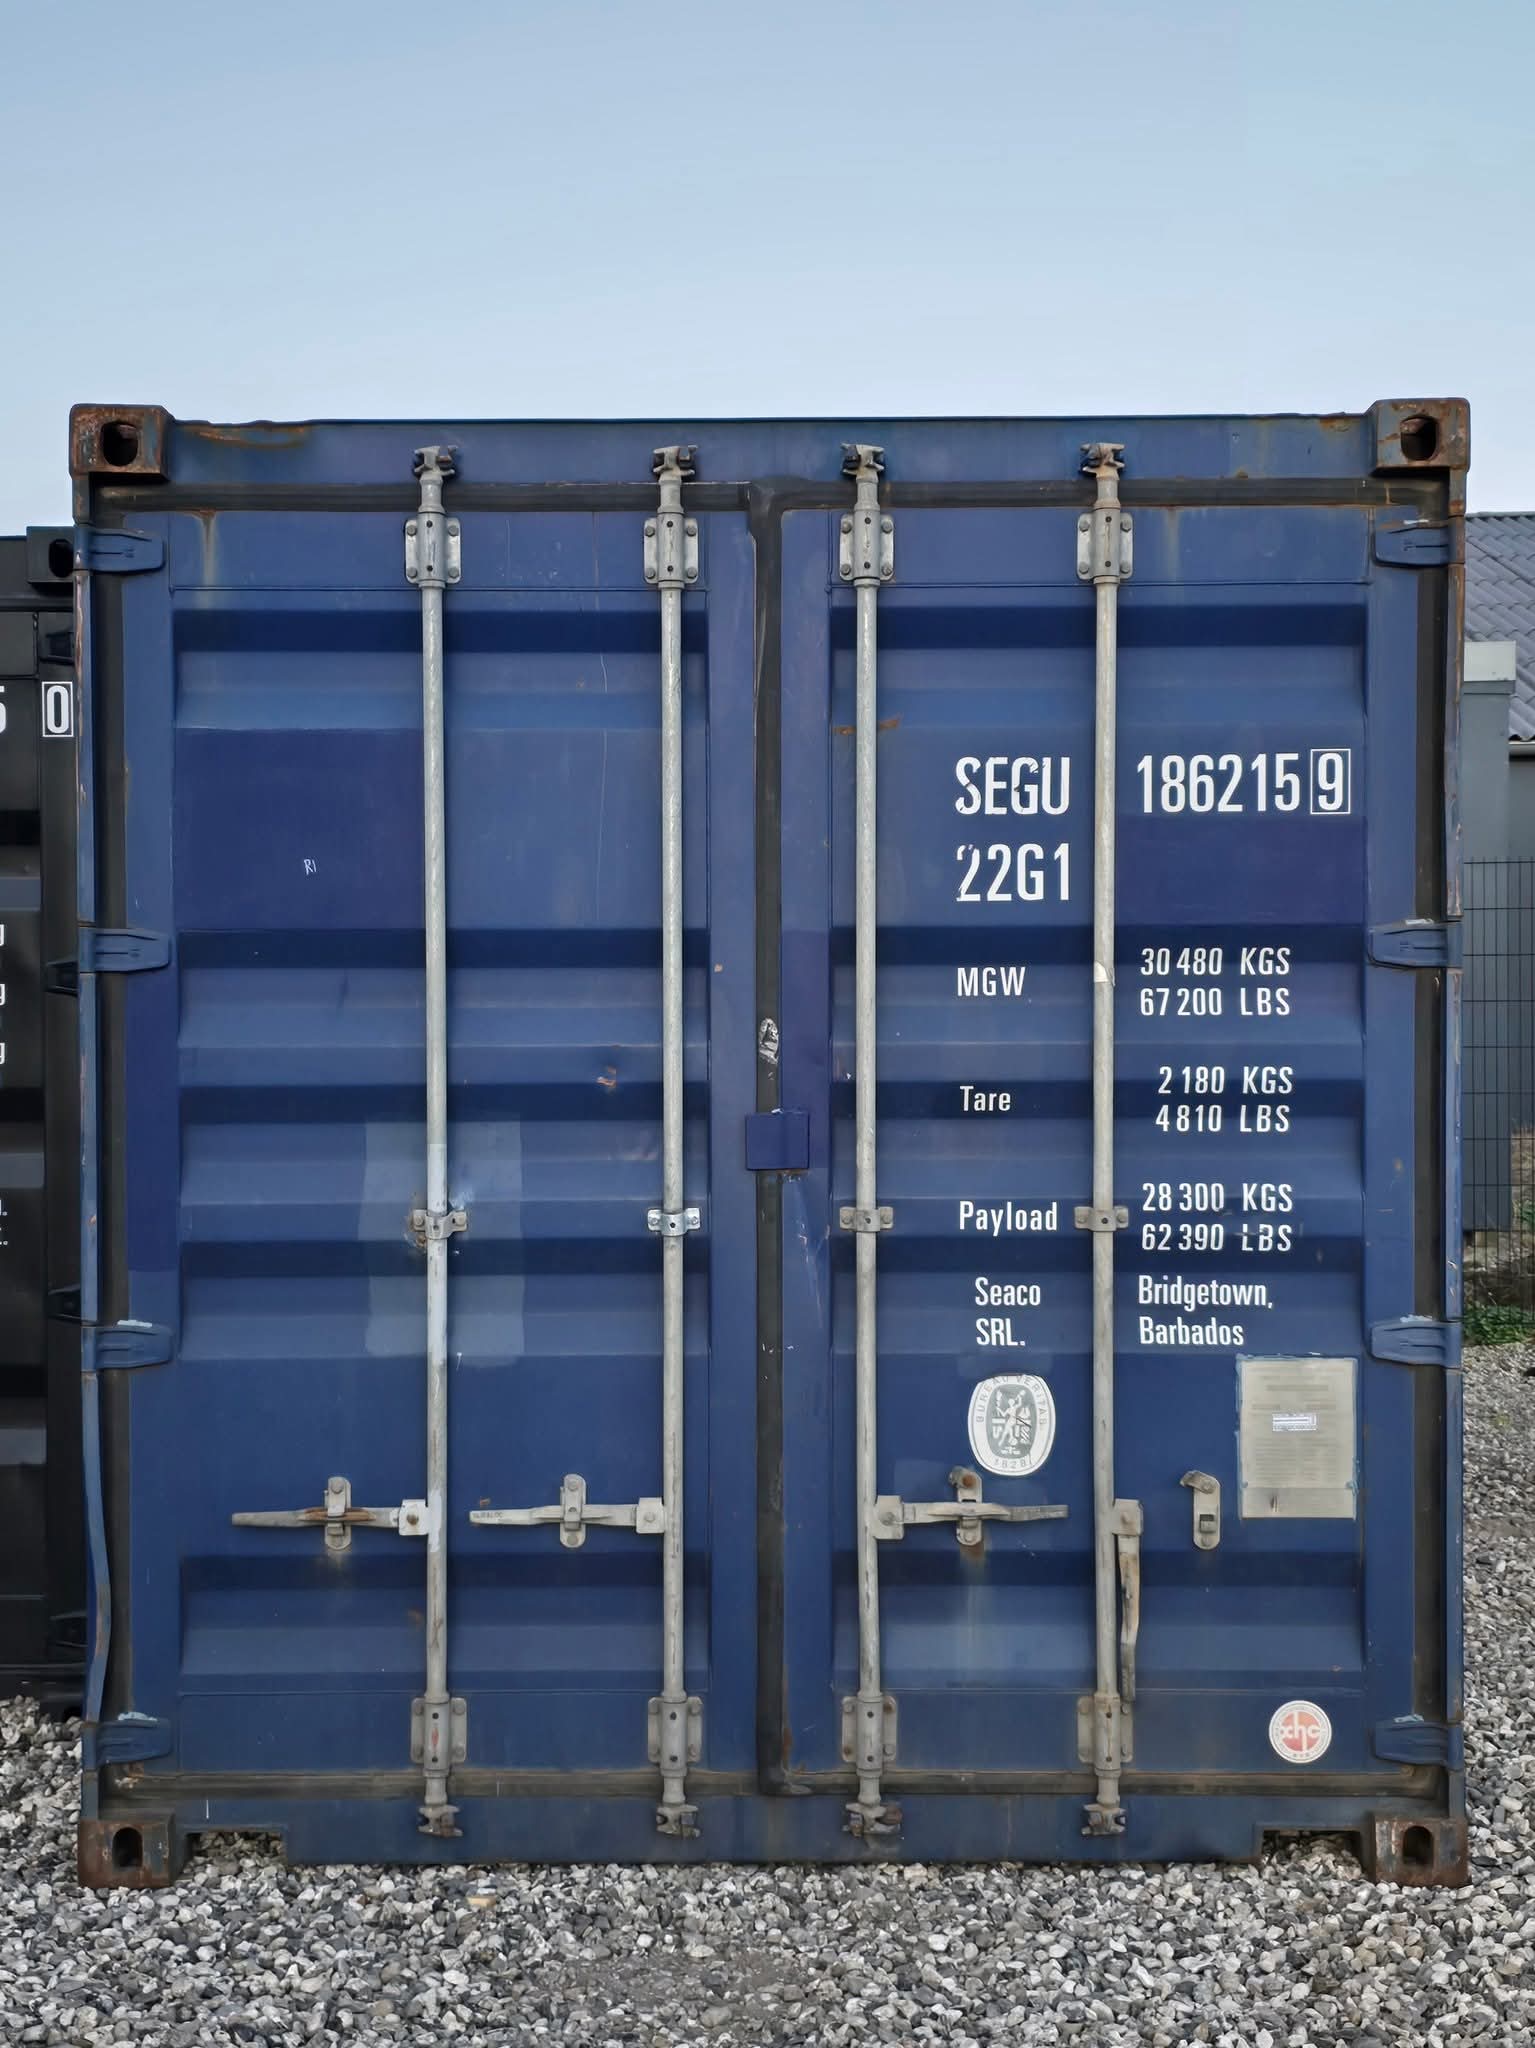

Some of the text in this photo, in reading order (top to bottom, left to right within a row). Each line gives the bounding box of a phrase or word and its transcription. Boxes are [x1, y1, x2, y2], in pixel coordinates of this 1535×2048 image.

[954, 756, 1070, 816] SEGU
[955, 842, 1069, 902] 22G1
[1240, 947, 1291, 976] KGS
[957, 966, 1026, 997] MGW
[1240, 987, 1290, 1016] LBS
[1242, 1066, 1294, 1094] KGS
[959, 1085, 1011, 1112] Tare
[1239, 1104, 1290, 1133] LBS
[1242, 1182, 1293, 1212] KGS
[959, 1200, 1058, 1237] Payload
[1241, 1223, 1293, 1252] LBS
[974, 1276, 1041, 1306] Seaco
[1138, 1274, 1273, 1313] Bridgetown,
[975, 1317, 1026, 1347] SRL.
[1139, 1316, 1244, 1346] Barbados
[974, 1375, 1010, 1423] BUREAU
[993, 1458, 1027, 1470] 1828
